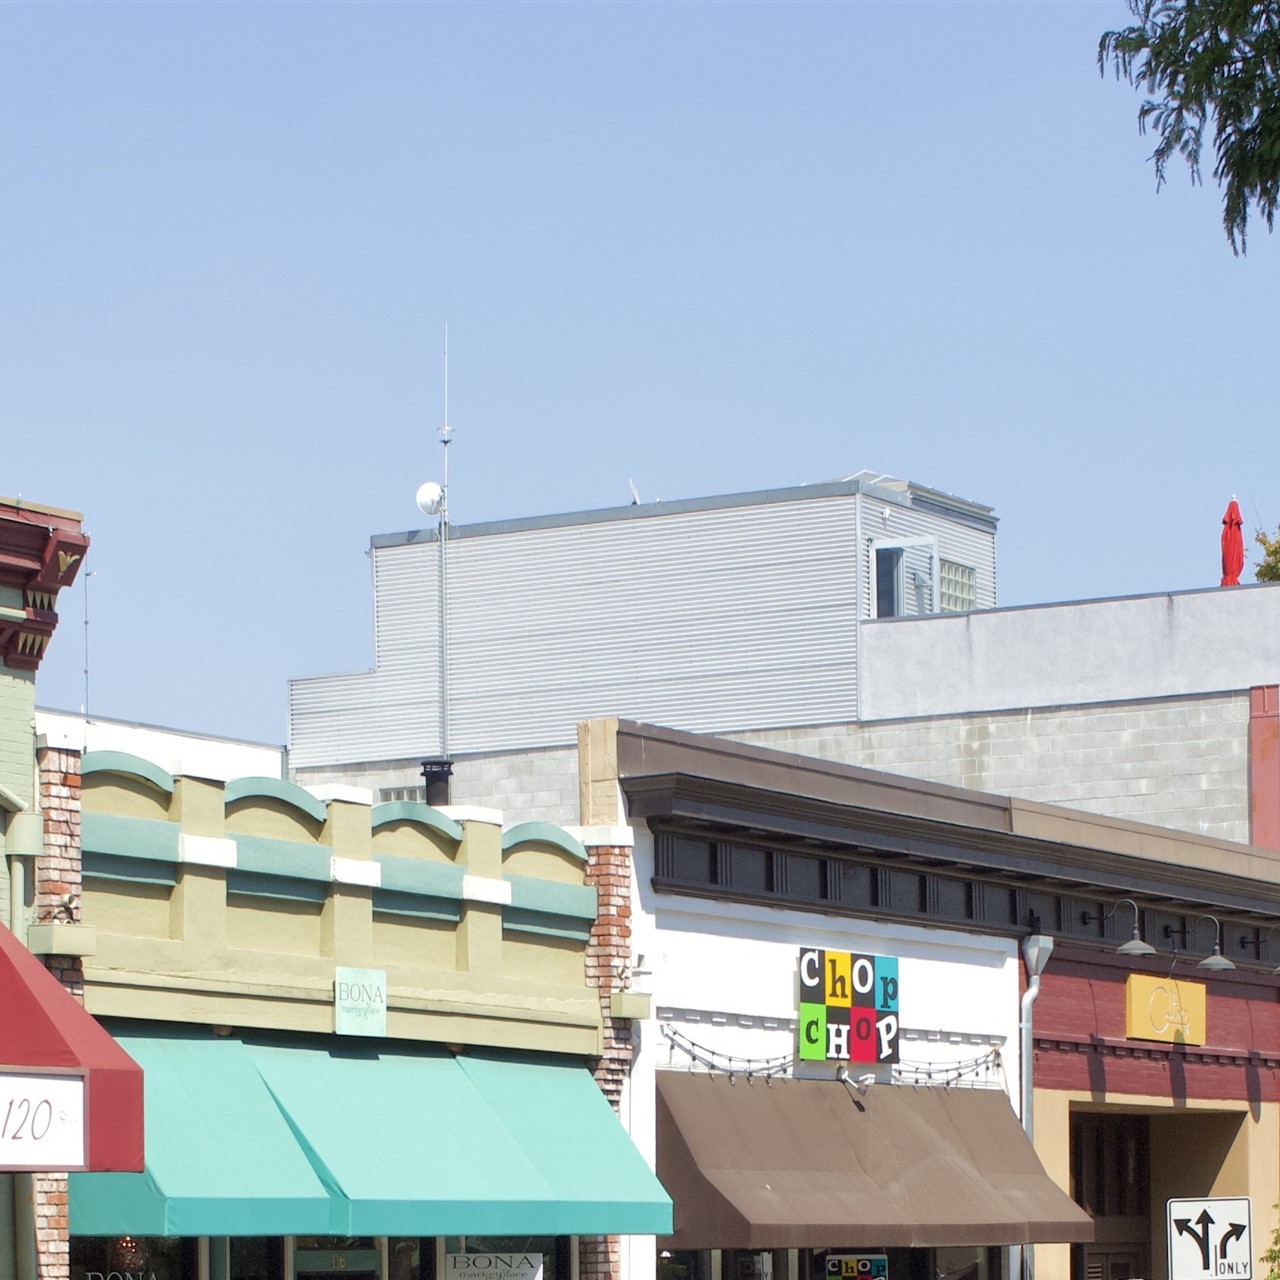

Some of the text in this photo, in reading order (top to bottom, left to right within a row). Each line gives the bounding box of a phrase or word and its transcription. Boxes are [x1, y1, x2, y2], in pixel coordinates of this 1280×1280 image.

[338, 982, 384, 1003] BONA
[341, 1001, 381, 1020] marketplace
[0, 1098, 53, 1141] 120
[451, 1255, 535, 1270] BONA
[1219, 1261, 1249, 1275] ONLY
[459, 1269, 528, 1280] marketplace
